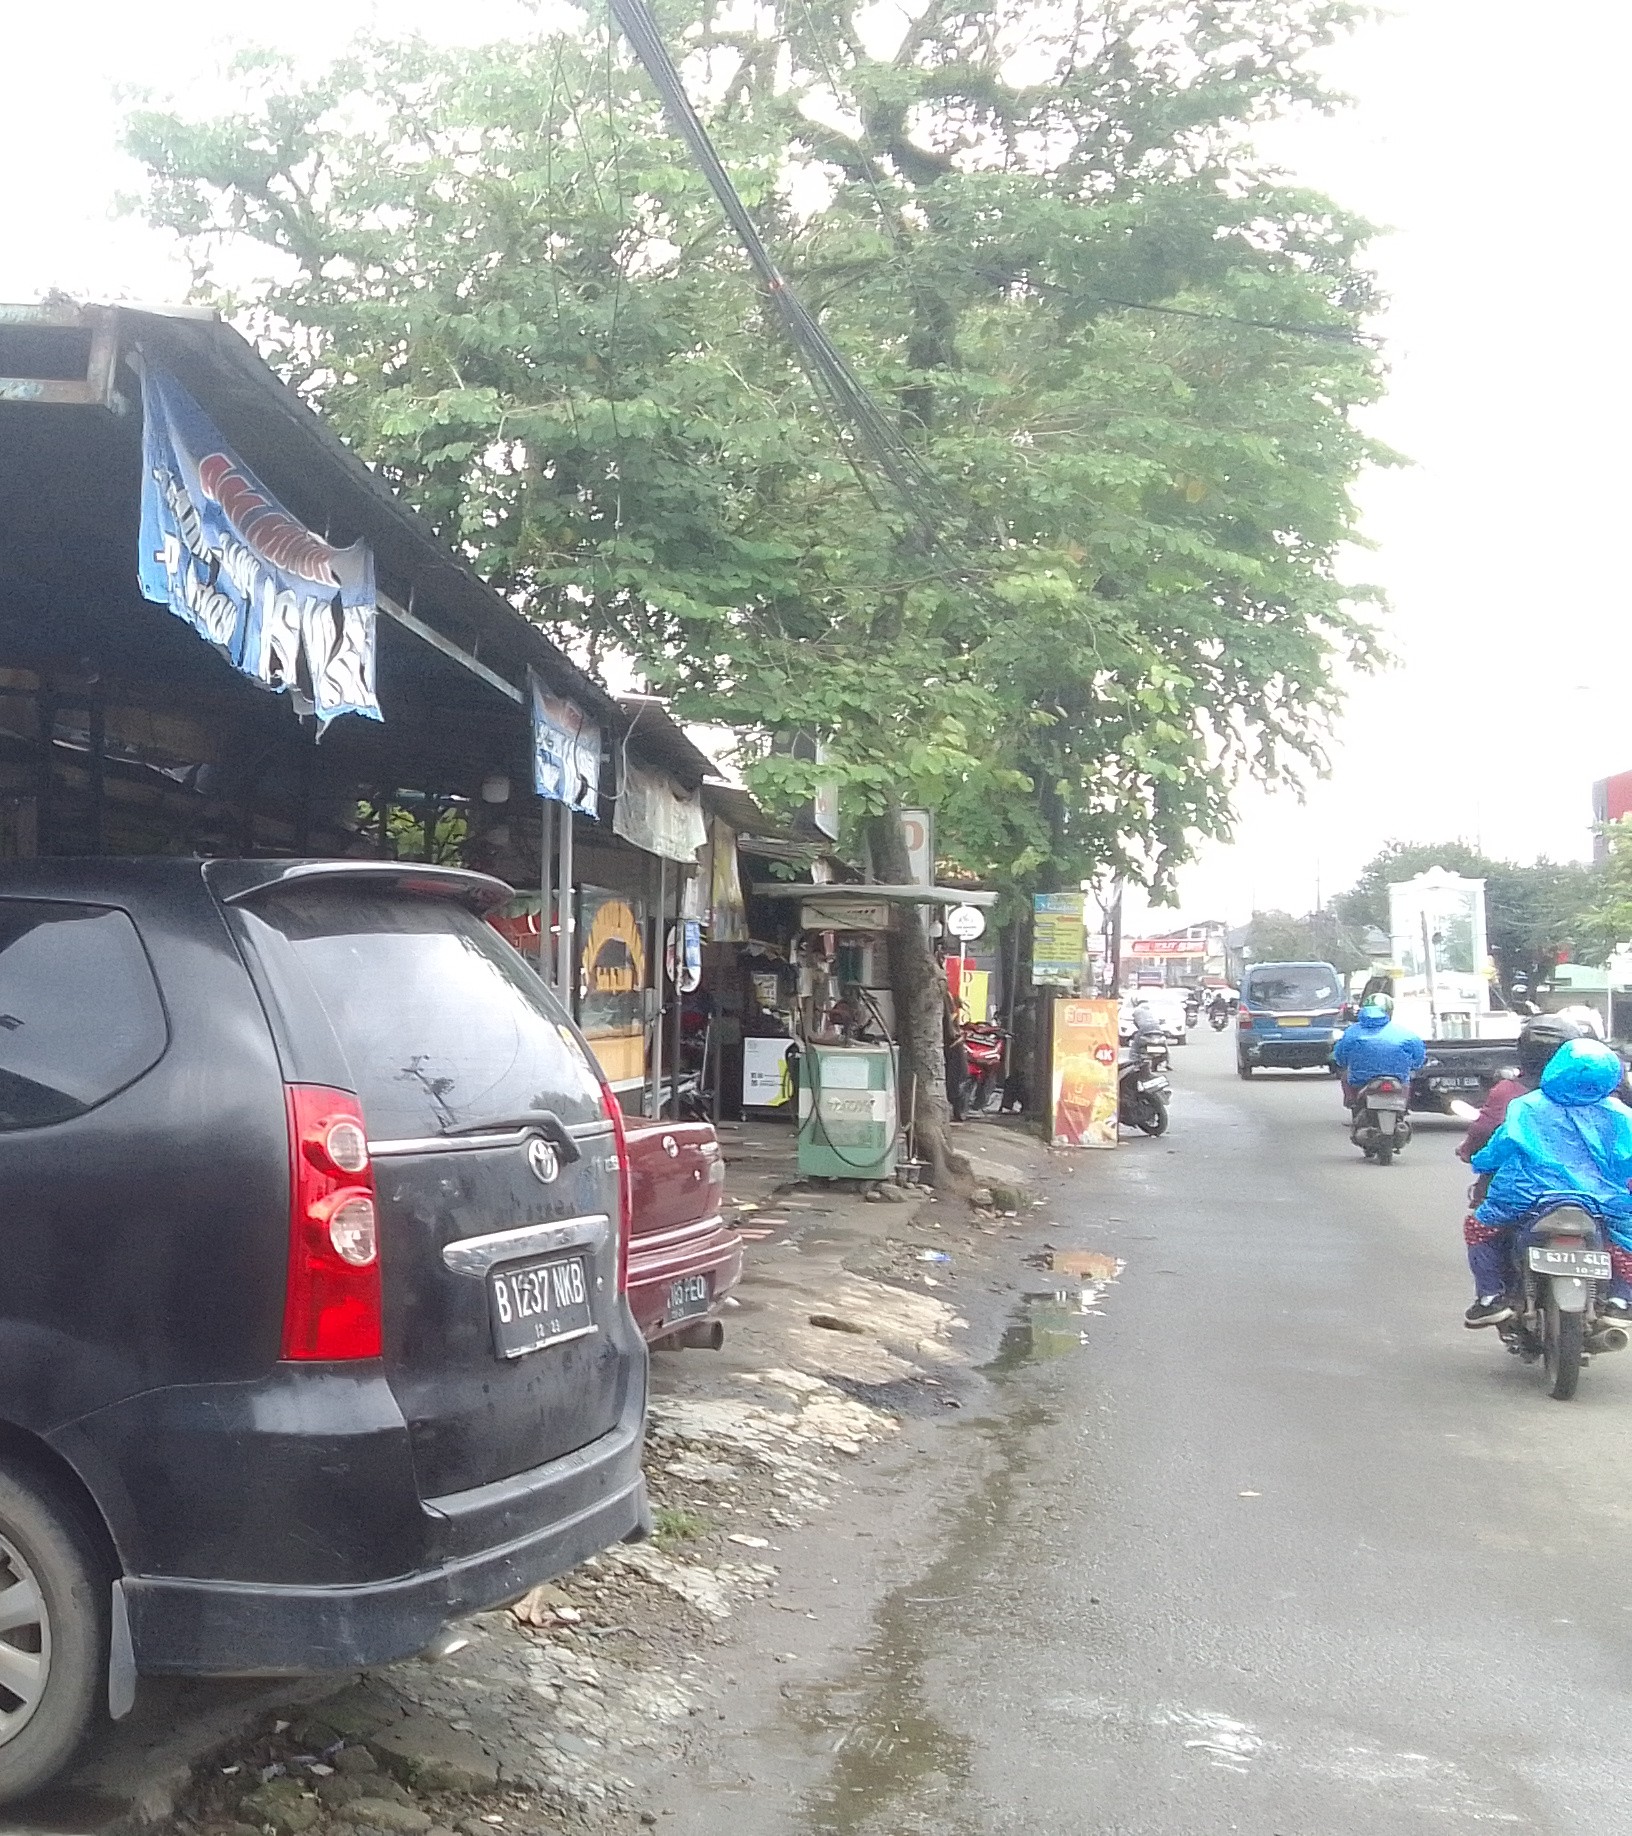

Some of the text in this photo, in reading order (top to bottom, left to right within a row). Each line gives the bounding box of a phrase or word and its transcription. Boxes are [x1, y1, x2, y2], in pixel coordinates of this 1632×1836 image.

[495, 1264, 584, 1323] B 1237 NKB
